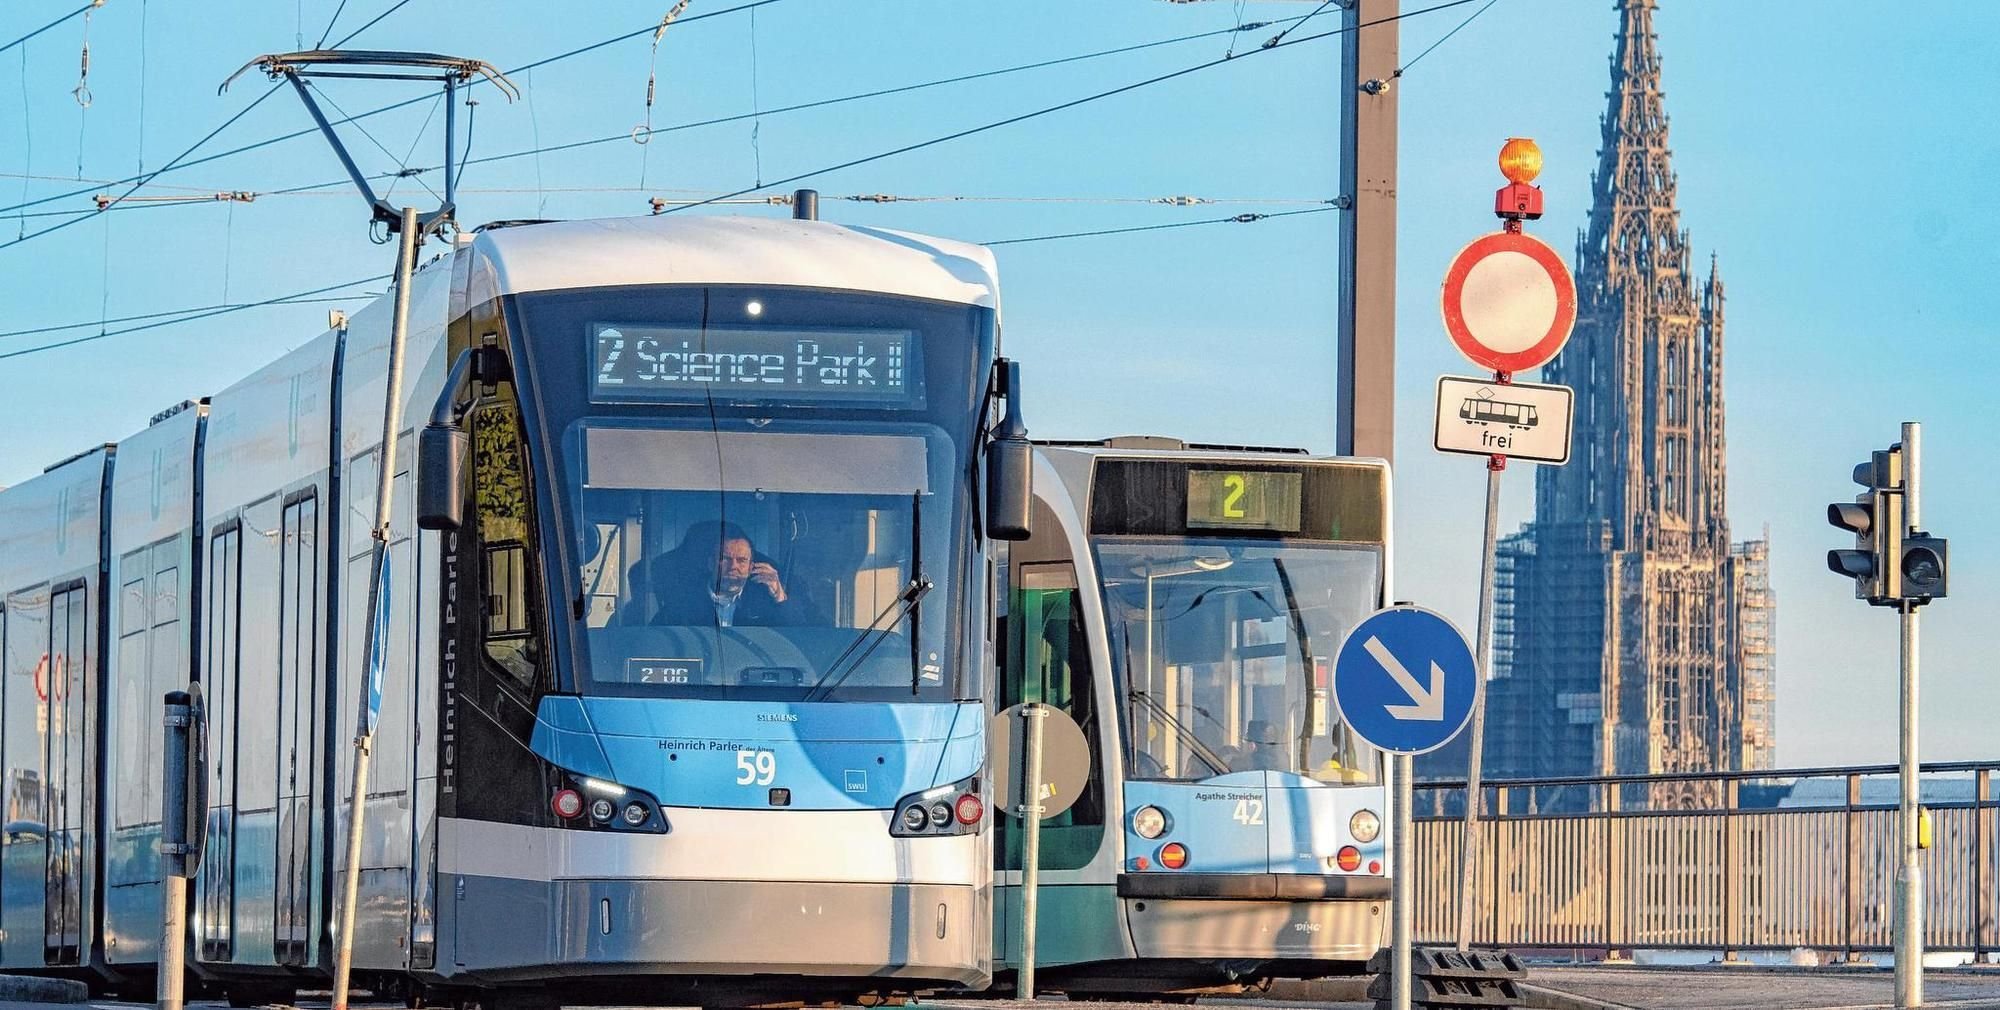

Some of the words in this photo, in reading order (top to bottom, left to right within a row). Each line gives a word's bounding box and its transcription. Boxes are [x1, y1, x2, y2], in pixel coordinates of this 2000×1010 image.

[598, 328, 624, 384] 2
[637, 337, 784, 384] Science
[797, 340, 876, 386] Park
[1482, 430, 1513, 449] frei
[1223, 474, 1245, 518] 2
[641, 667, 653, 684] 2
[443, 638, 456, 793] Heinrich
[757, 714, 798, 722] SIEMENS
[658, 740, 706, 751] Heinrich
[709, 740, 743, 752] Parler
[736, 751, 776, 786] 59
[1195, 792, 1226, 802] Agathe
[1227, 792, 1263, 801] Streicher
[1232, 799, 1264, 825] 42
